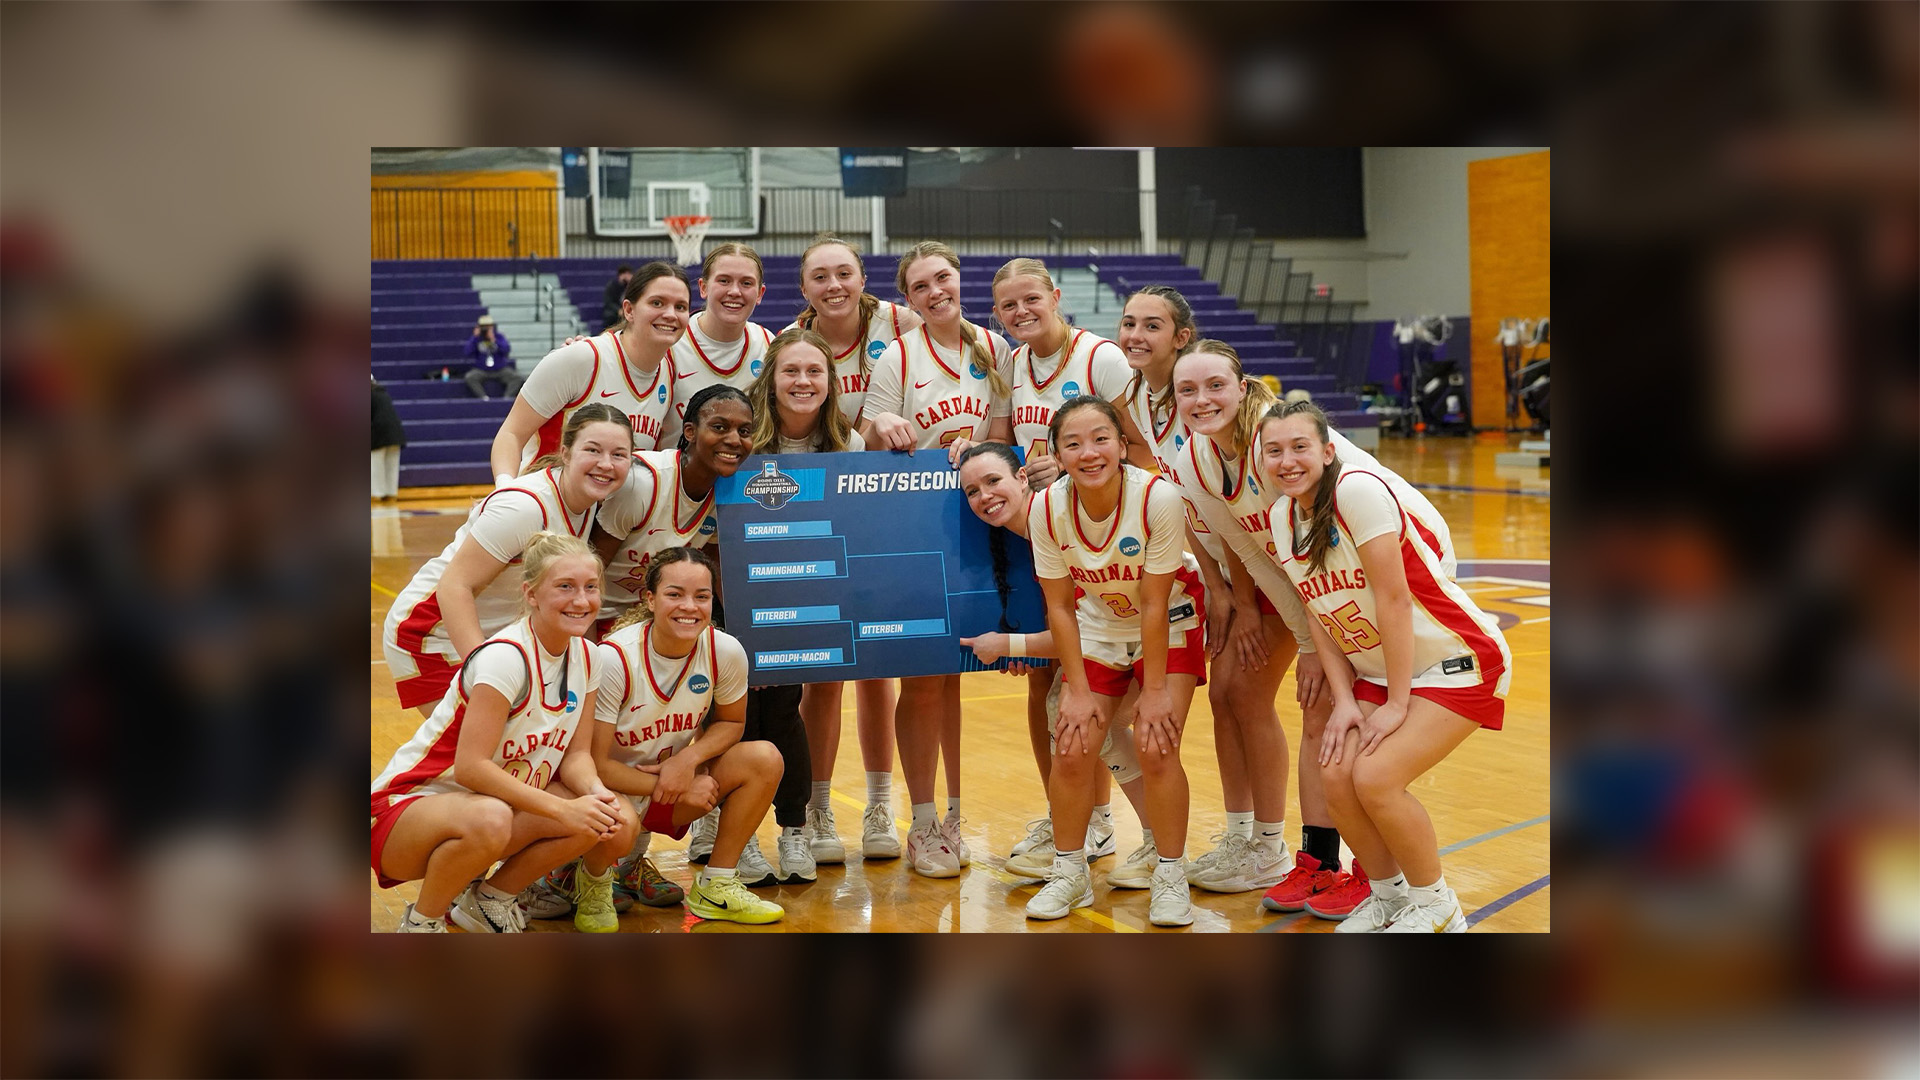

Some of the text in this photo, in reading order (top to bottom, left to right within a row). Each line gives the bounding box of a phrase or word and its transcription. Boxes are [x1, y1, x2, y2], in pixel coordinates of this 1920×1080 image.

[837, 470, 960, 494] FIRST/SECON
[746, 486, 799, 495] CHAMPIONSHIP
[747, 525, 789, 535] SCRANTON
[1123, 544, 1141, 553] NCAA
[751, 564, 818, 576] FRAMINGHAM ST.
[1100, 592, 1140, 618] 2
[755, 610, 797, 621] OTTERBEIN
[862, 623, 903, 635] OTTERBEIN
[1319, 600, 1381, 655] 25
[758, 651, 830, 664] RANDOLPH-MACON
[692, 682, 709, 690] NCAA
